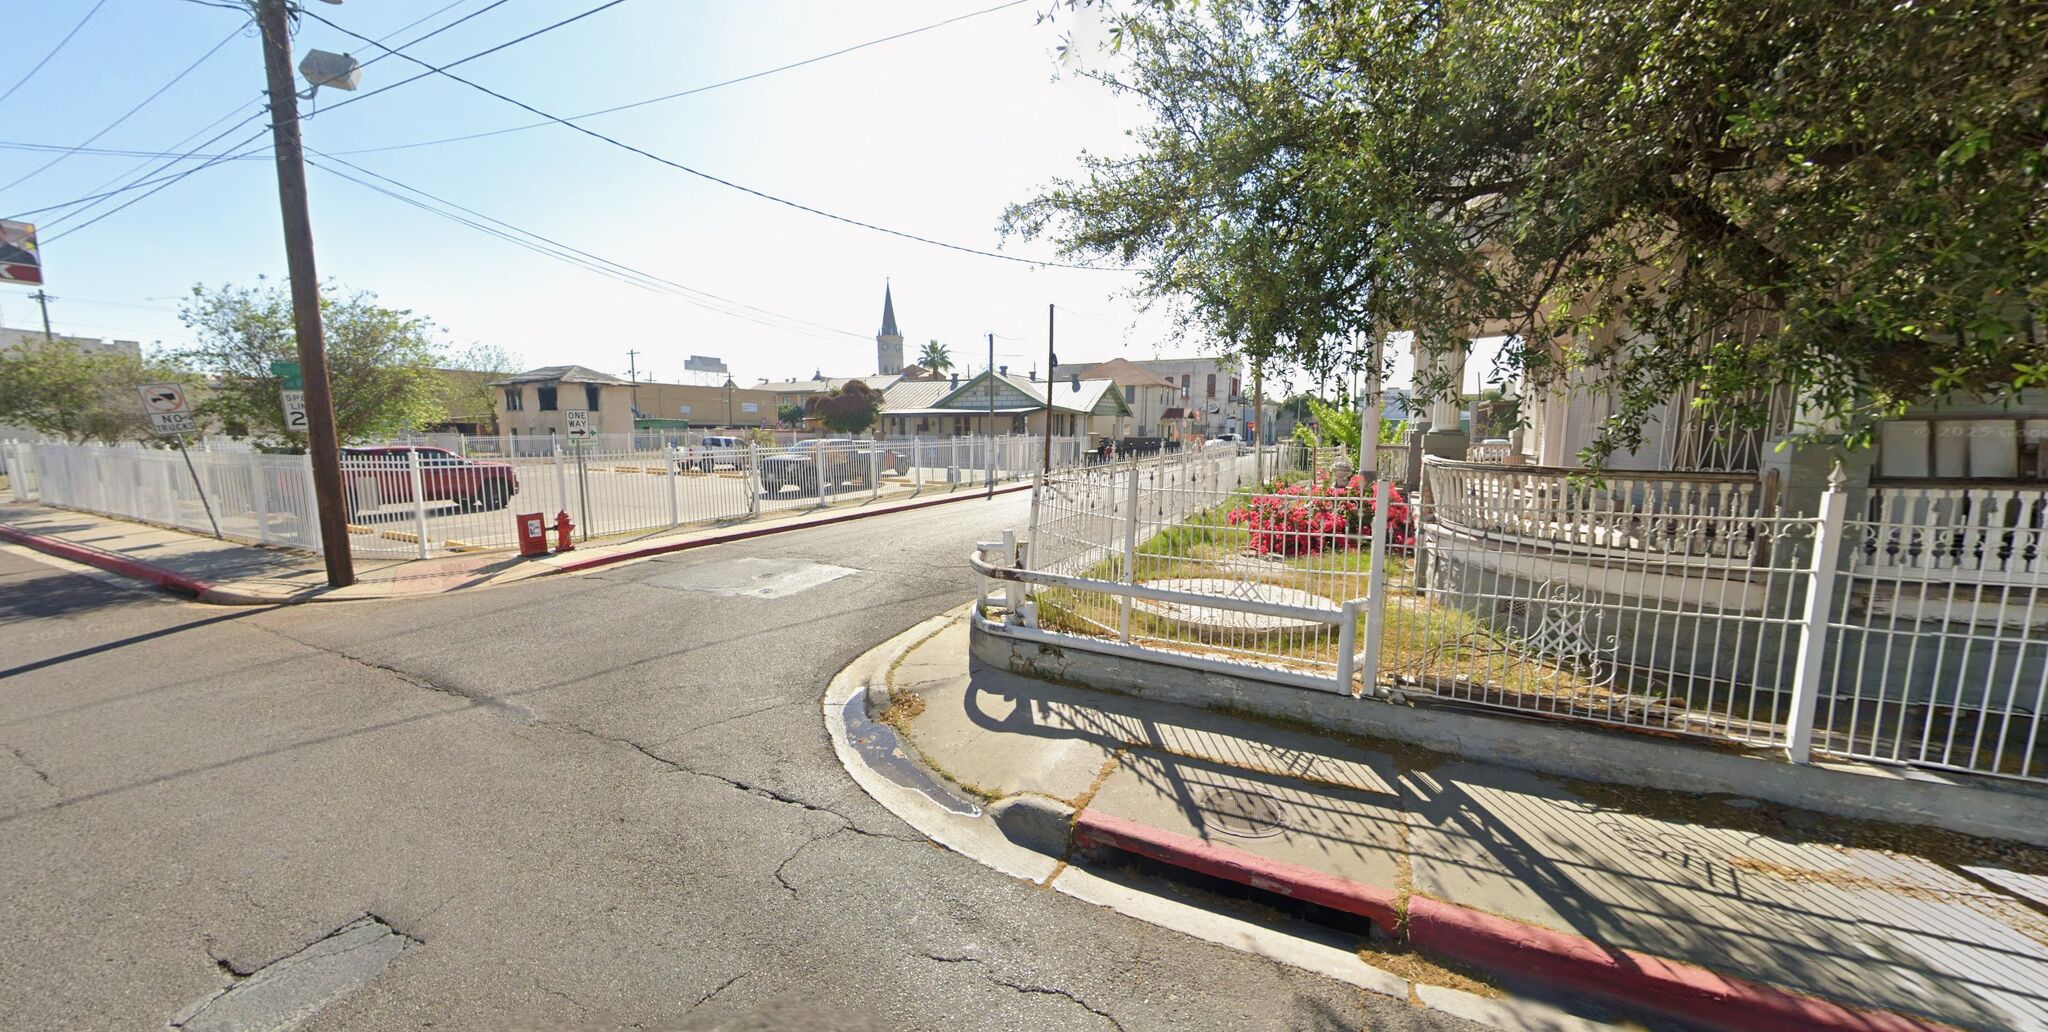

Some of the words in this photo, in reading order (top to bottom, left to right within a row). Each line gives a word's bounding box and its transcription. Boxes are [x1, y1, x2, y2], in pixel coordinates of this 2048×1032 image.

[161, 415, 182, 423] NO
[568, 411, 586, 420] ONE
[156, 423, 193, 432] TRUCKS
